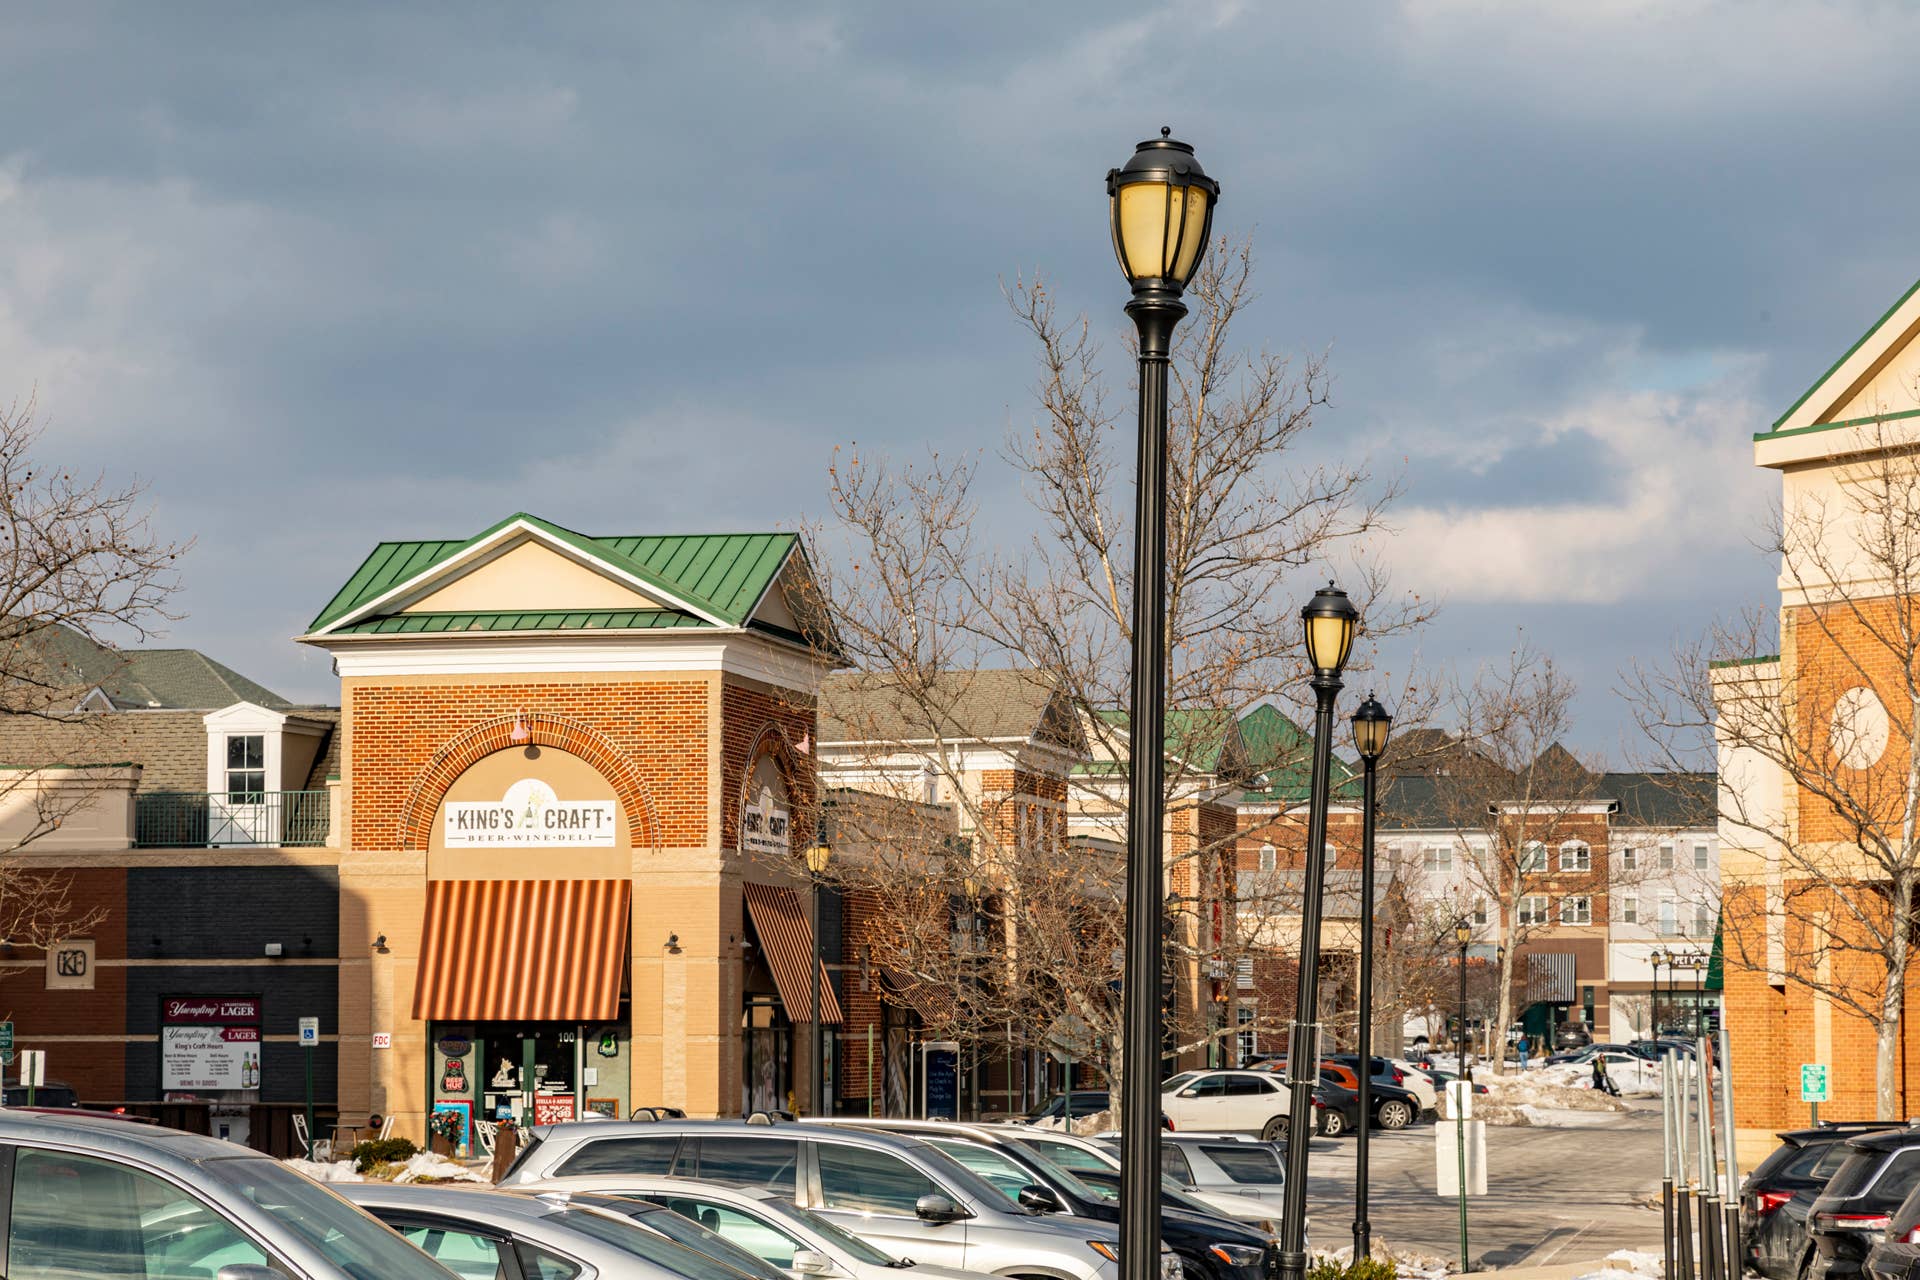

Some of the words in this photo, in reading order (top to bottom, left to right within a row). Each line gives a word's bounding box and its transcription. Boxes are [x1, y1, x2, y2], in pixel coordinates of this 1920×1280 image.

[458, 808, 514, 829] KING'S
[545, 809, 604, 829] CRAFT
[1674, 955, 1689, 965] PET
[168, 1001, 219, 1017] Yuengling
[220, 1007, 254, 1016] LAGER
[165, 1028, 209, 1040] Yuengling
[228, 1032, 257, 1040] LAGER
[559, 1032, 574, 1042] 100
[374, 1036, 388, 1045] FDC
